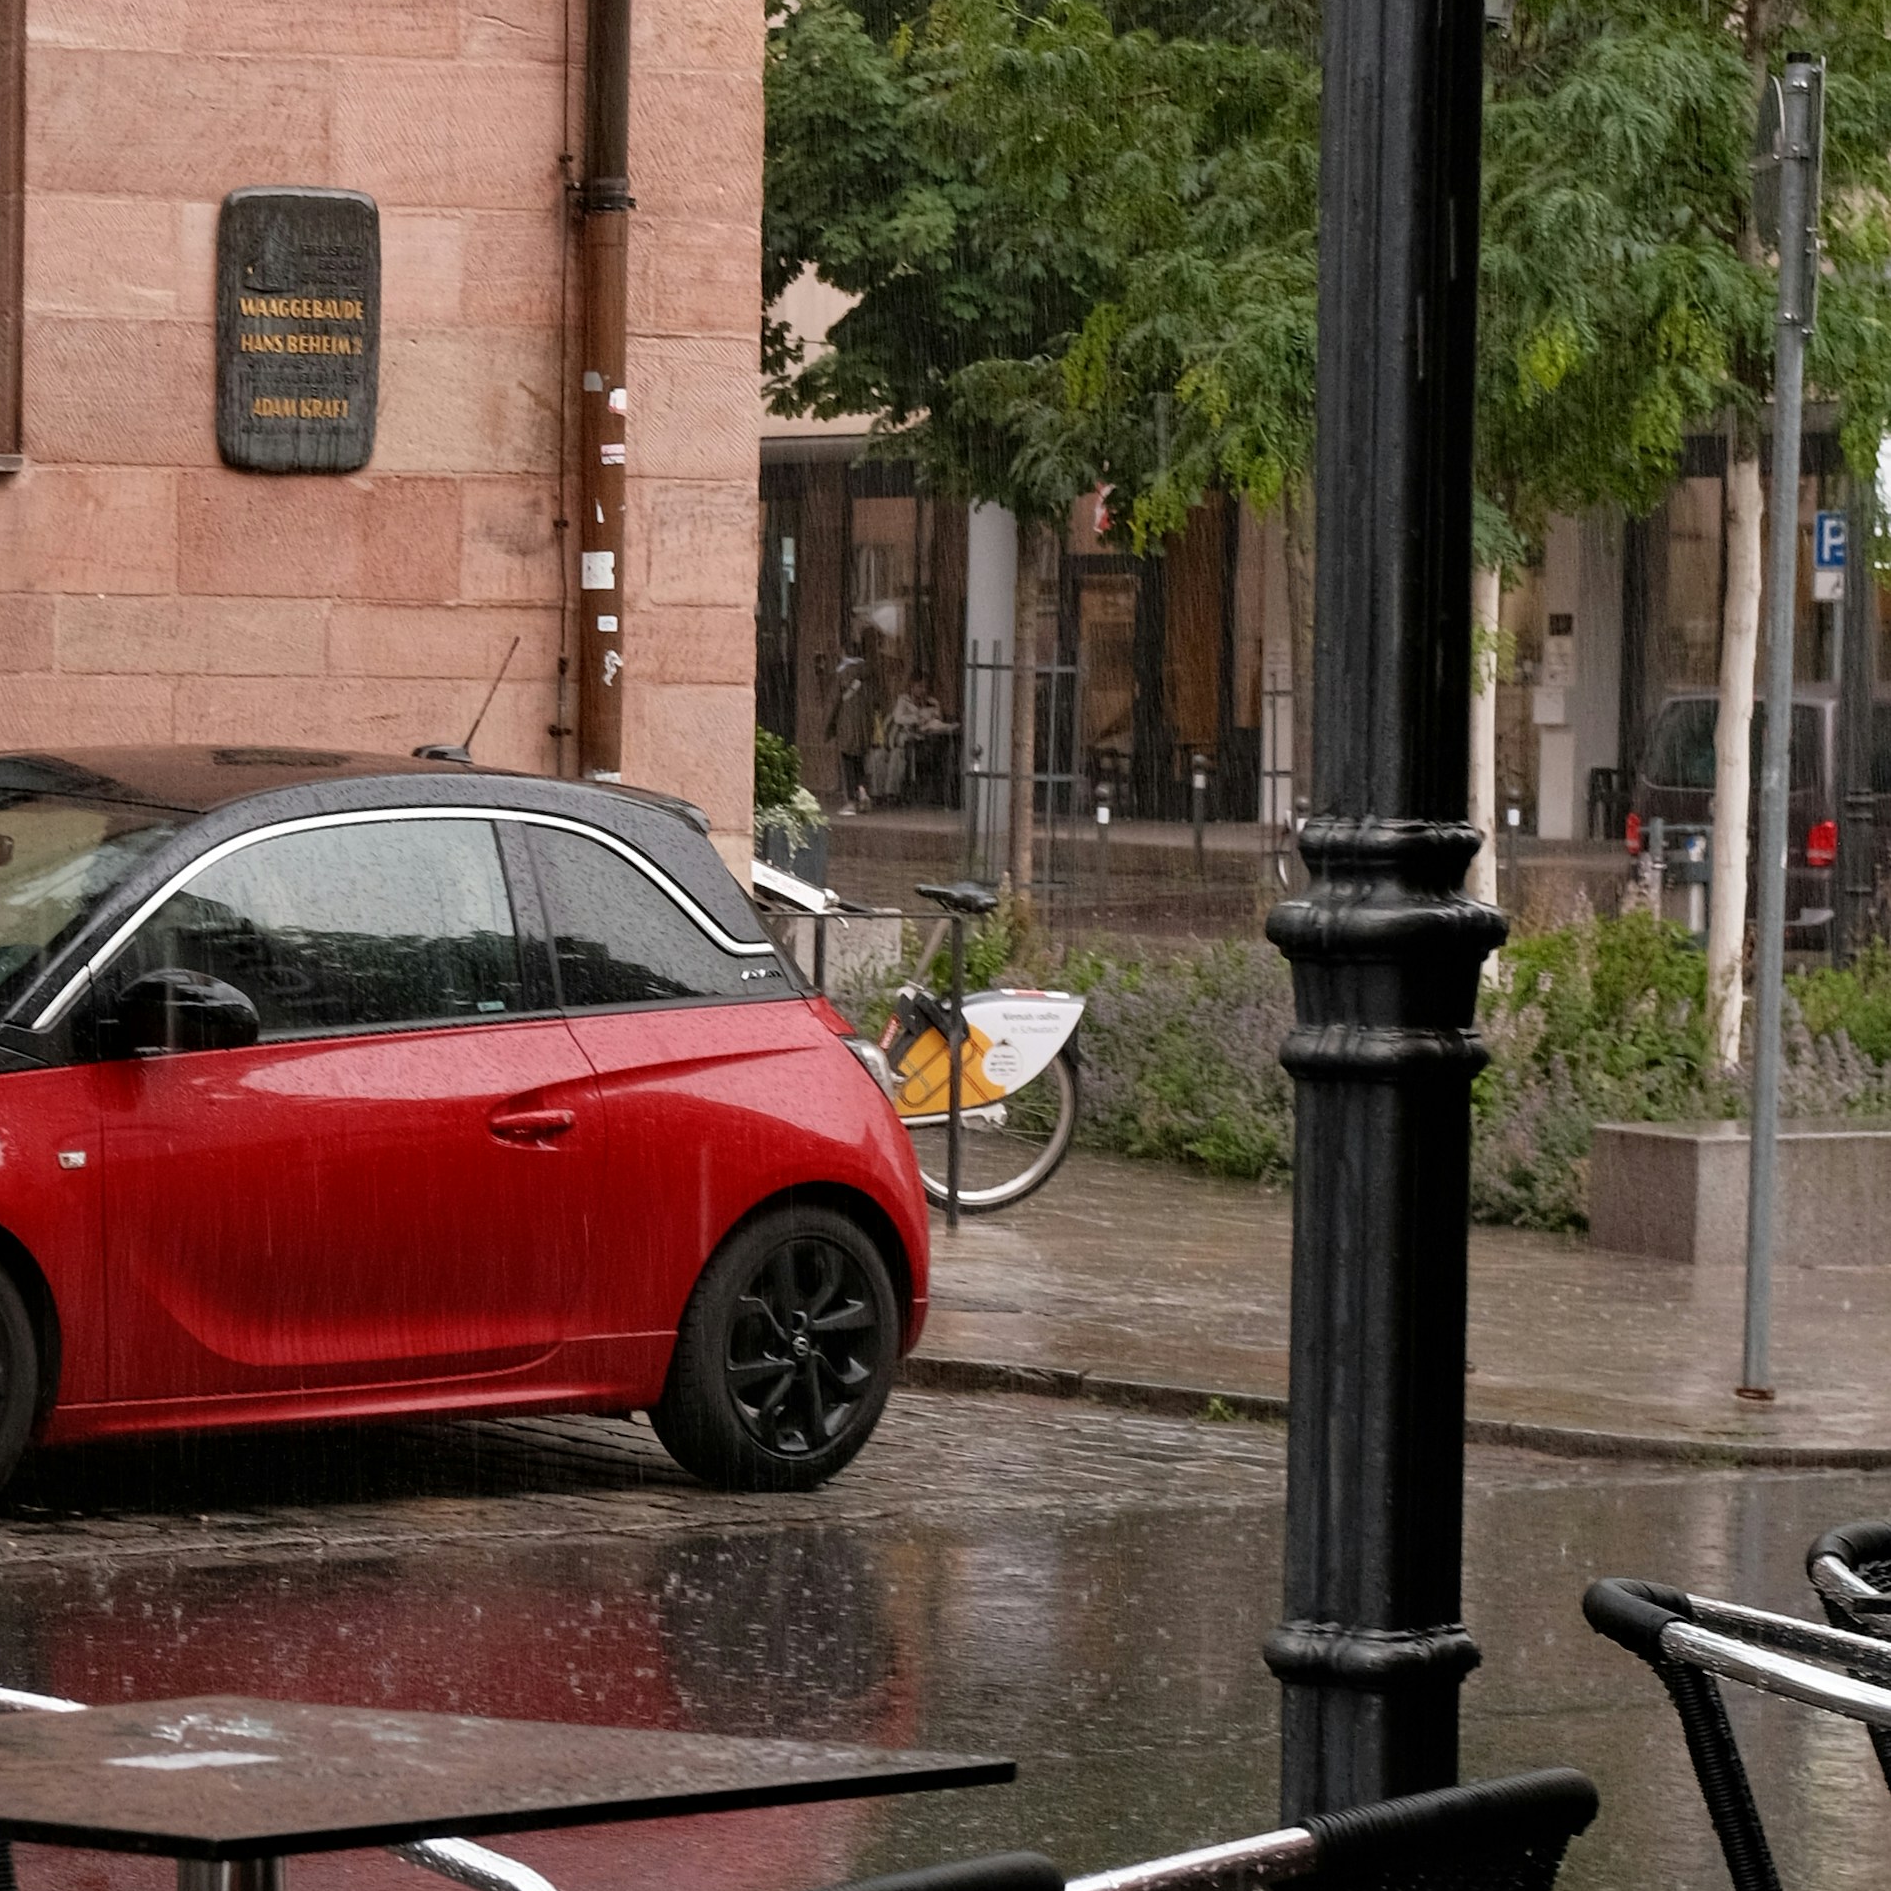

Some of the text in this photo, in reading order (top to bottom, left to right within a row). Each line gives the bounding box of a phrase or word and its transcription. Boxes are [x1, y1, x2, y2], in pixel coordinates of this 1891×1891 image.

[241, 333, 284, 354] HANS
[286, 334, 351, 355] BEHEIM
[252, 397, 349, 420] ADAM KRAFT
[1822, 519, 1846, 562] P
